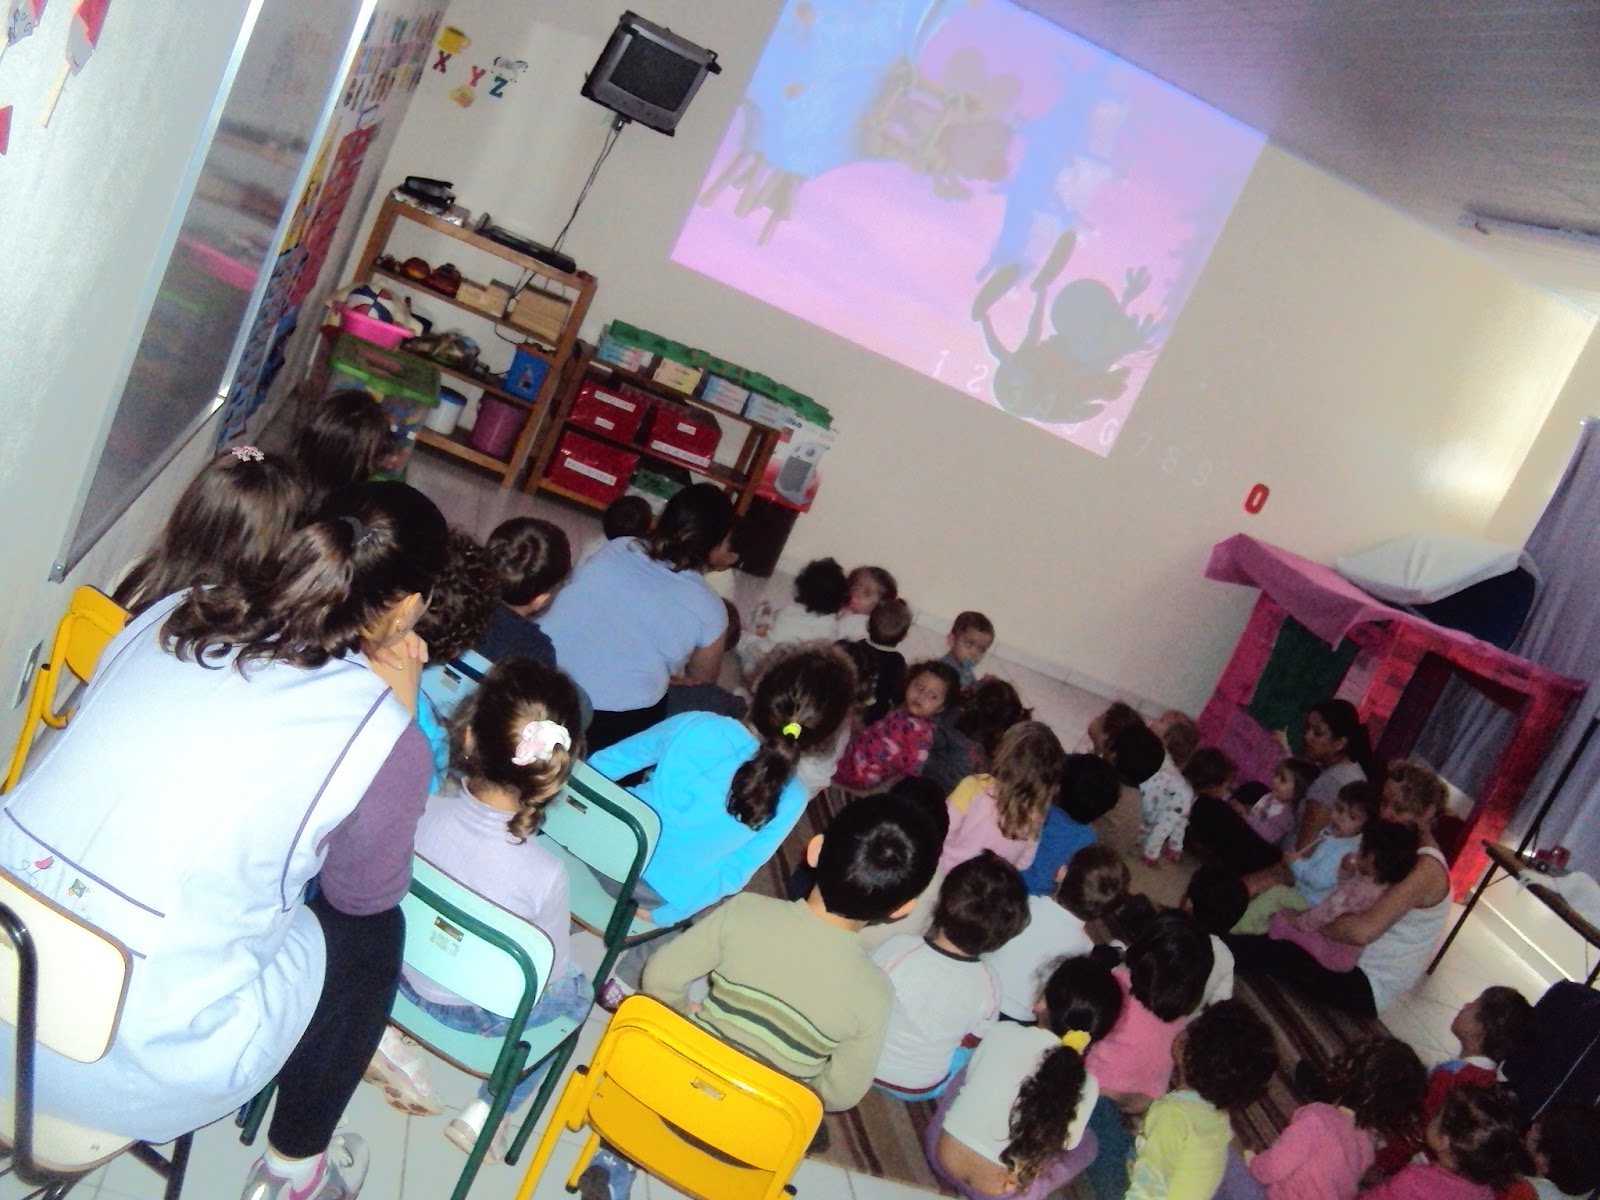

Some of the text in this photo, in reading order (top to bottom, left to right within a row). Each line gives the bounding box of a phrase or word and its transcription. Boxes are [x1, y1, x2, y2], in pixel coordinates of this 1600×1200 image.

[432, 50, 508, 99] X Y Z
[932, 349, 950, 379] 1
[966, 364, 989, 393] 2
